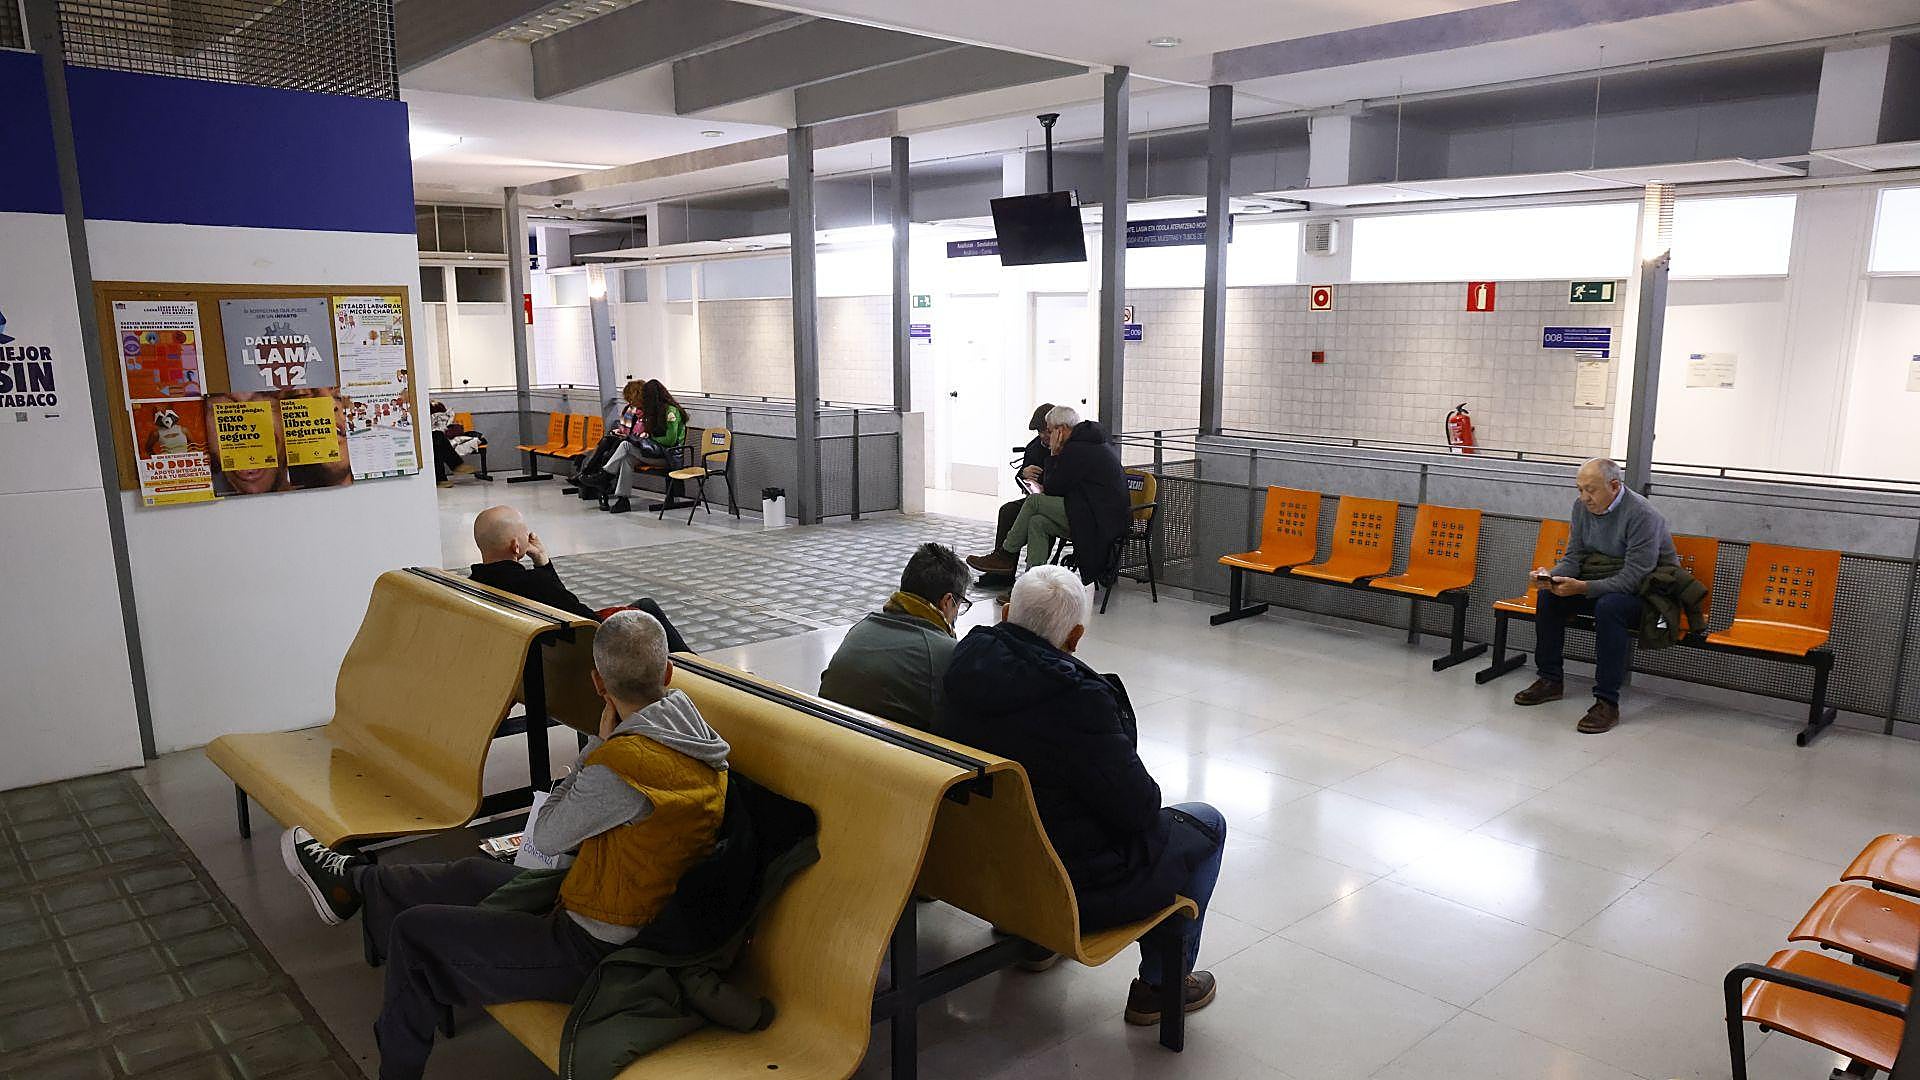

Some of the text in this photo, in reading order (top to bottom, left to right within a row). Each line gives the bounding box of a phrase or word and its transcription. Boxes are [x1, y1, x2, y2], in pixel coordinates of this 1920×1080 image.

[244, 334, 312, 346] DATE VIDA
[1544, 333, 1563, 342] 008
[241, 346, 323, 365] LLAMA
[0, 361, 56, 393] SIN
[259, 365, 307, 387] 112
[0, 393, 57, 408] TABACO
[217, 415, 244, 423] sexo
[282, 411, 309, 420] sexu
[218, 423, 257, 432] libre y
[284, 417, 332, 428] libre eta
[219, 432, 260, 442] seguro
[285, 427, 331, 438] segurua
[146, 458, 211, 471] NO DUDES
